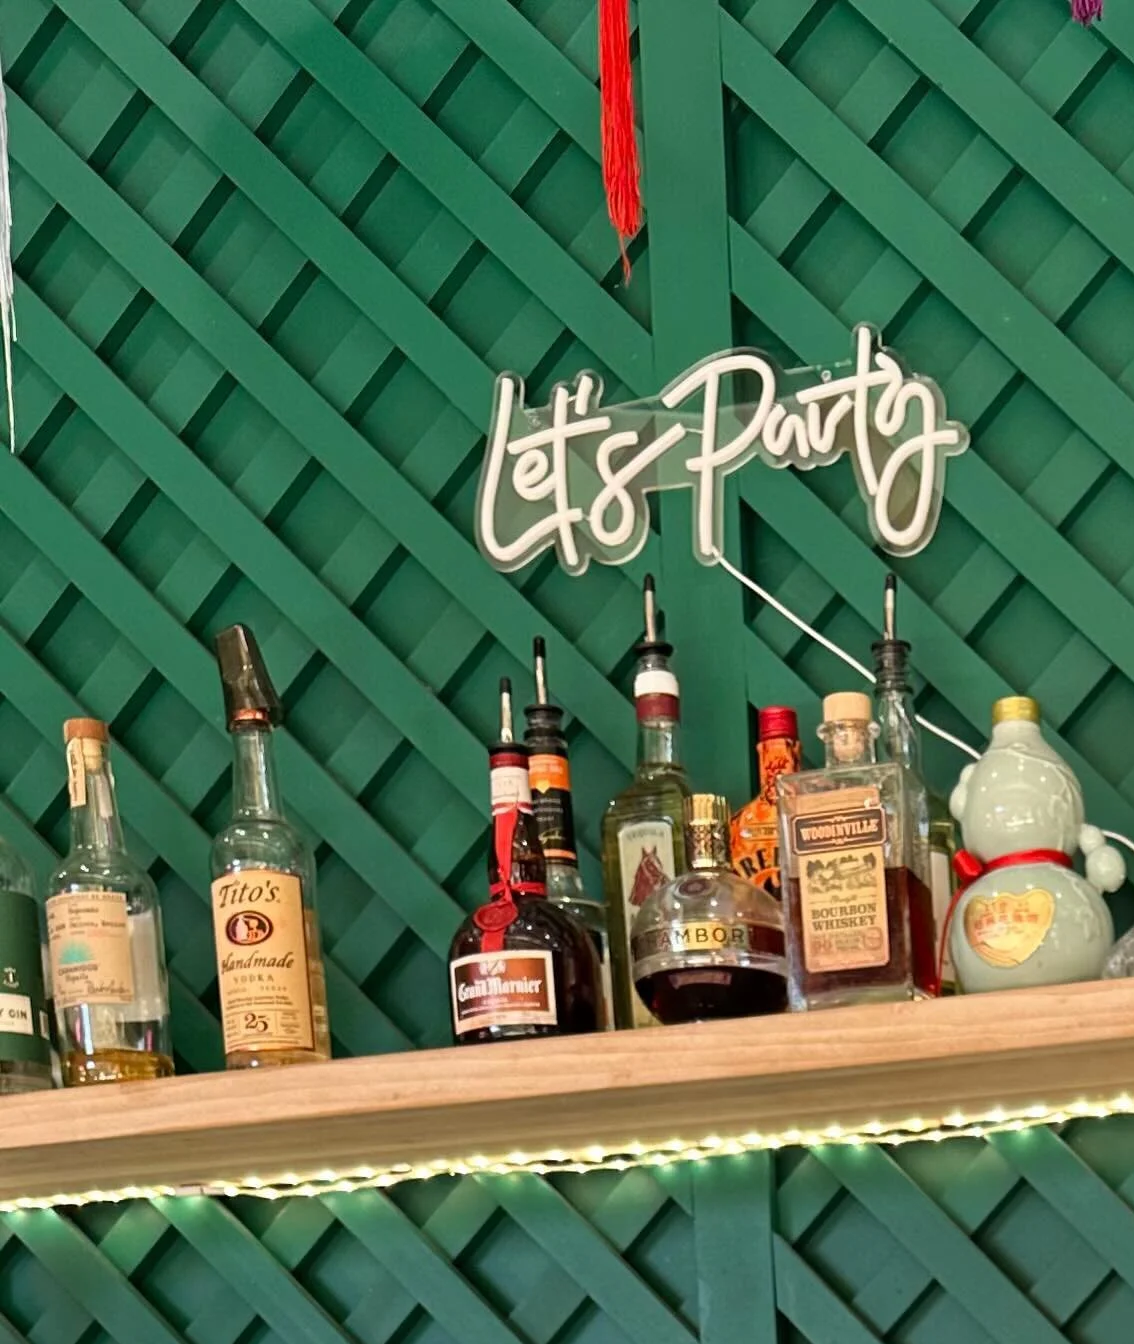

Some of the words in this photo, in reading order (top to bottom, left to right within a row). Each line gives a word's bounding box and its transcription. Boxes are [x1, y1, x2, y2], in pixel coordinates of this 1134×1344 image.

[481, 374, 686, 566] Let's
[661, 326, 958, 555] Party
[800, 818, 880, 841] WOODINVILLE
[218, 879, 281, 909] Tito's
[811, 902, 877, 920] BOURBON
[811, 914, 877, 931] WHISKEY
[221, 950, 295, 975] Handmade
[233, 973, 275, 985] VODKA
[487, 975, 542, 995] Marnier
[8, 1008, 28, 1020] GIN
[244, 1012, 269, 1033] 25
